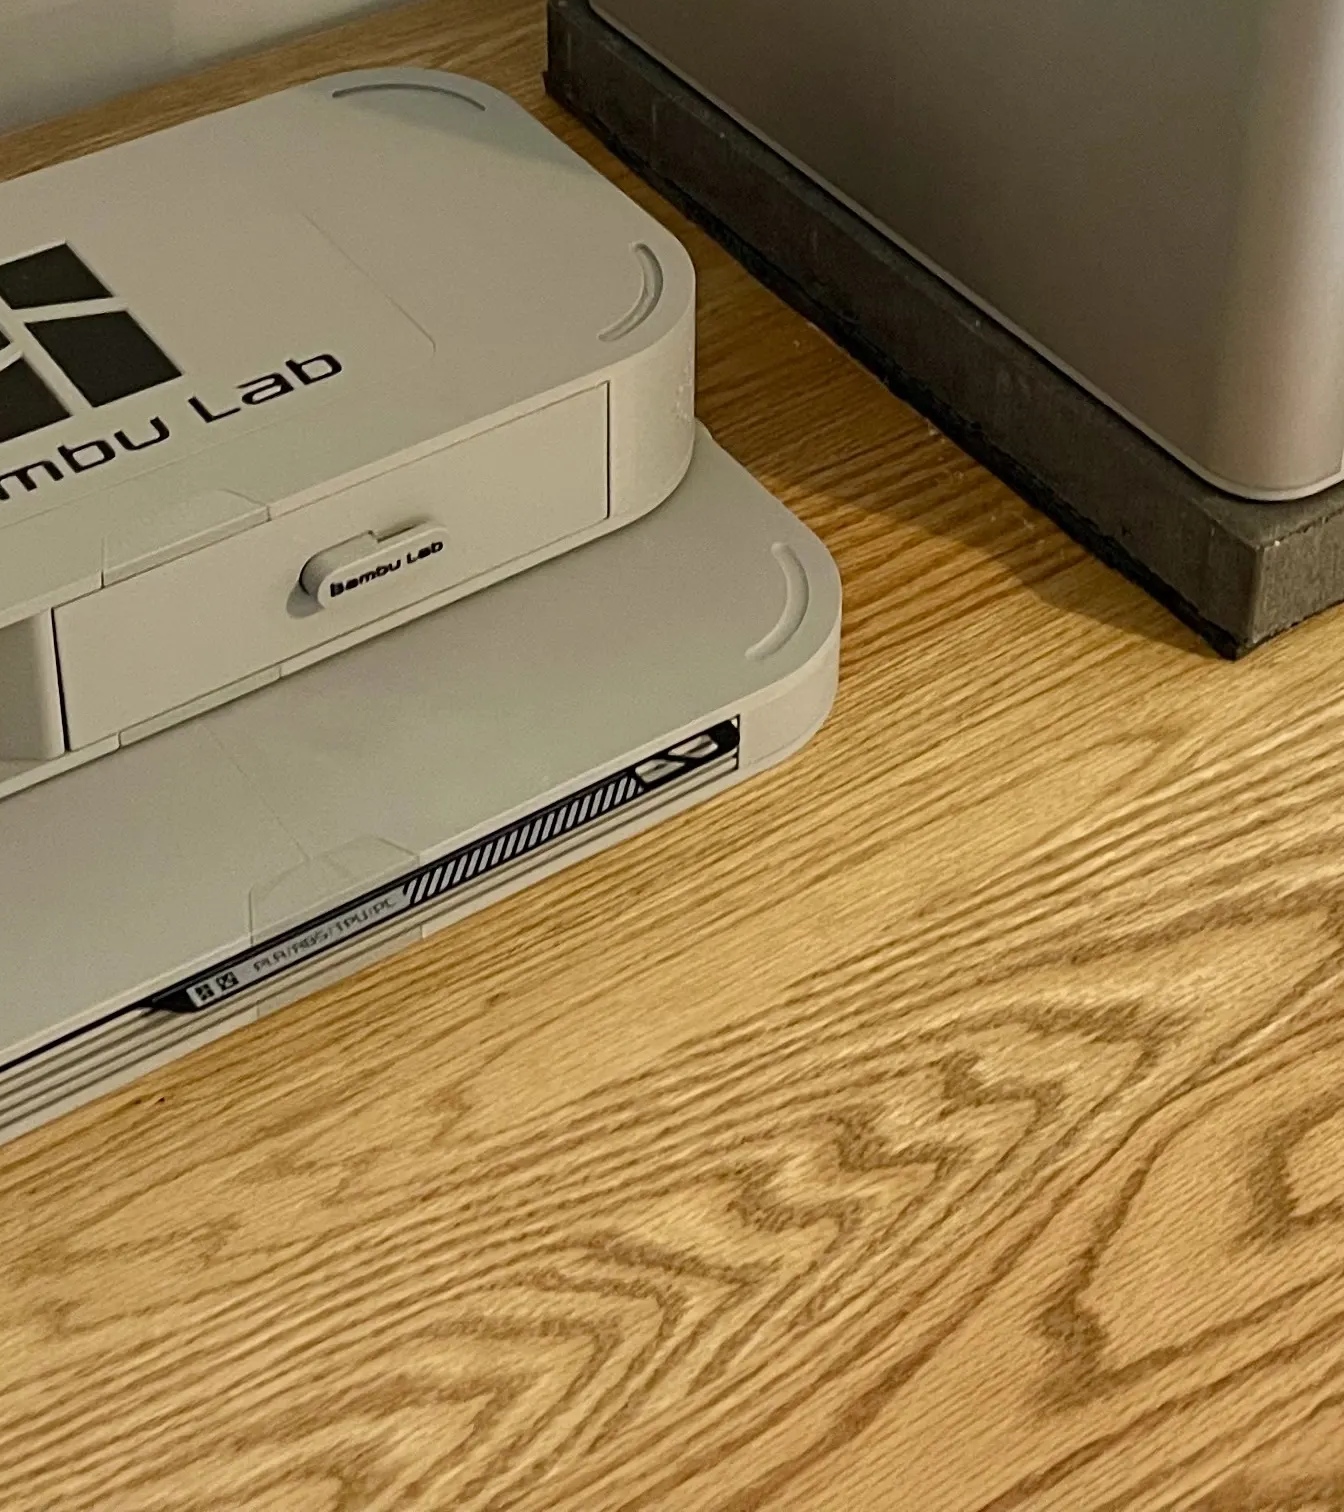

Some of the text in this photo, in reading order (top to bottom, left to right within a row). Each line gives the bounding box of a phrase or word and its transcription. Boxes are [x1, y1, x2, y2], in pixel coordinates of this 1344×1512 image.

[187, 351, 344, 424] Lab
[330, 541, 444, 598] Bambu Lab
